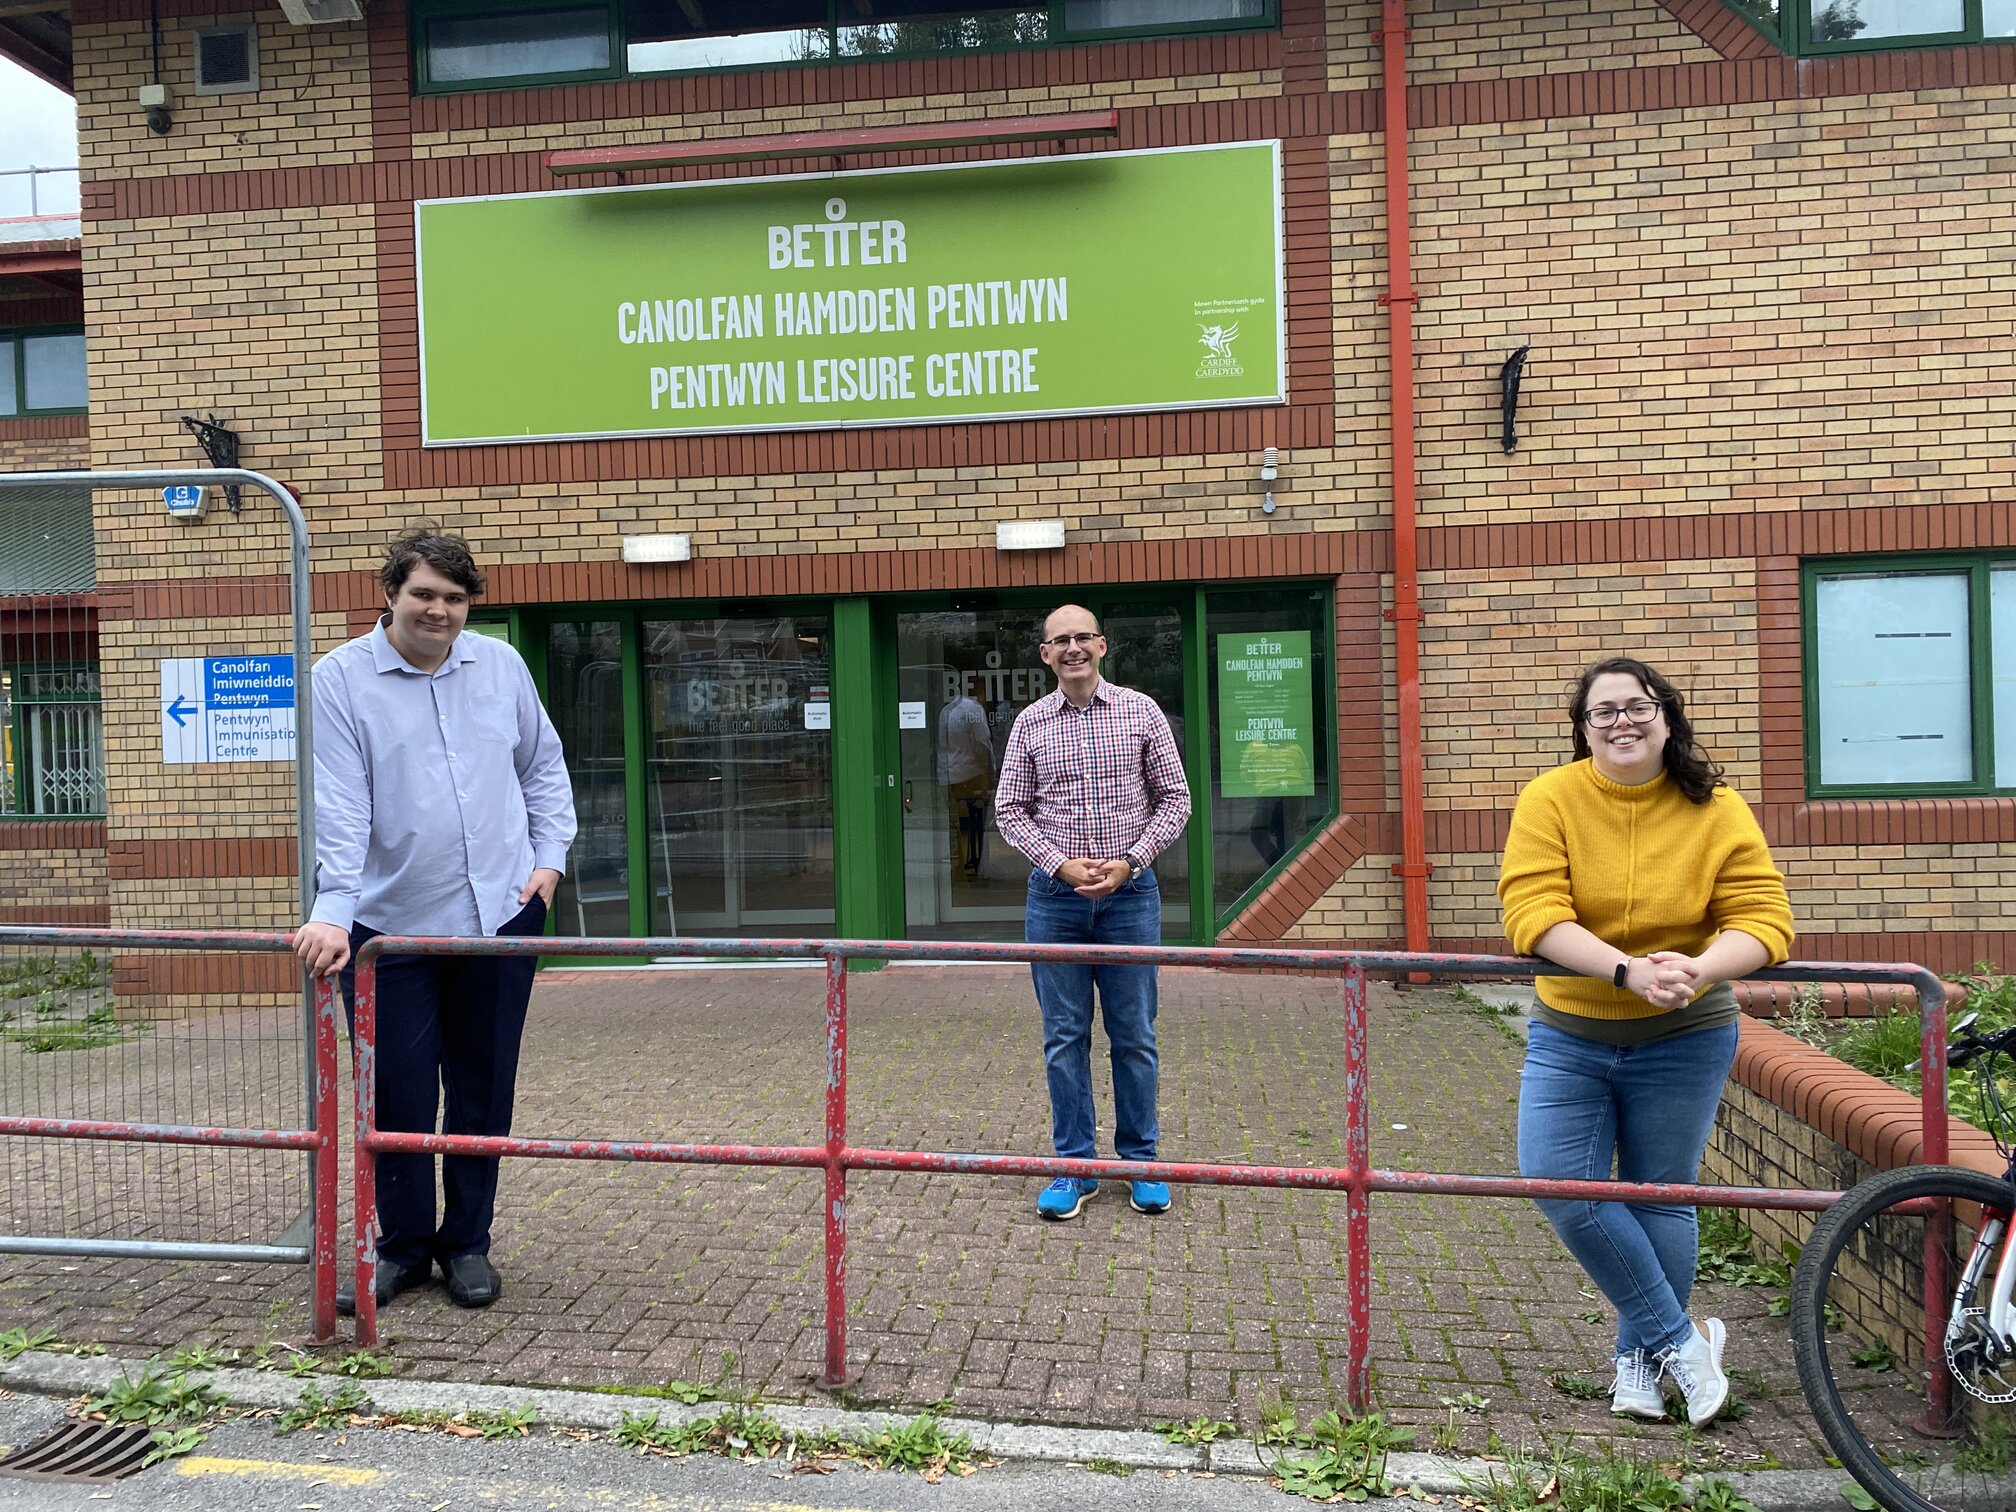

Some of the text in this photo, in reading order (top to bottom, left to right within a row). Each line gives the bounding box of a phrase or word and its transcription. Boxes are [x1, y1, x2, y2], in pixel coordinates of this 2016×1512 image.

[767, 219, 907, 270] BETTER
[1250, 297, 1265, 305] gyda
[618, 277, 1068, 344] CANOLFAN HAMDDEN PENTWYN
[1202, 307, 1235, 316] partnership
[1200, 358, 1238, 367] CARDIFF
[650, 347, 1039, 409] PENTWYN LEISURE CENTRE
[1195, 366, 1244, 377] CAERDYDD
[1246, 642, 1282, 656] BETTER
[212, 659, 271, 674] Canolfan
[1226, 657, 1303, 672] CANOLFAN HAMDDEN
[213, 675, 294, 690] Imiwneiddio
[1246, 669, 1283, 682] PENTWYN
[943, 668, 1047, 703] BETTER
[213, 693, 269, 707] Pentwyn
[686, 678, 789, 713] BETTER
[214, 713, 270, 727] Pentwyn
[709, 719, 728, 733] feel
[732, 719, 758, 735] good
[761, 718, 790, 734] place
[1248, 717, 1284, 730] PENTWYN
[215, 728, 296, 741] Immunisatio
[1236, 728, 1297, 742] LEISURE CENTRE
[216, 745, 258, 757] Centre
